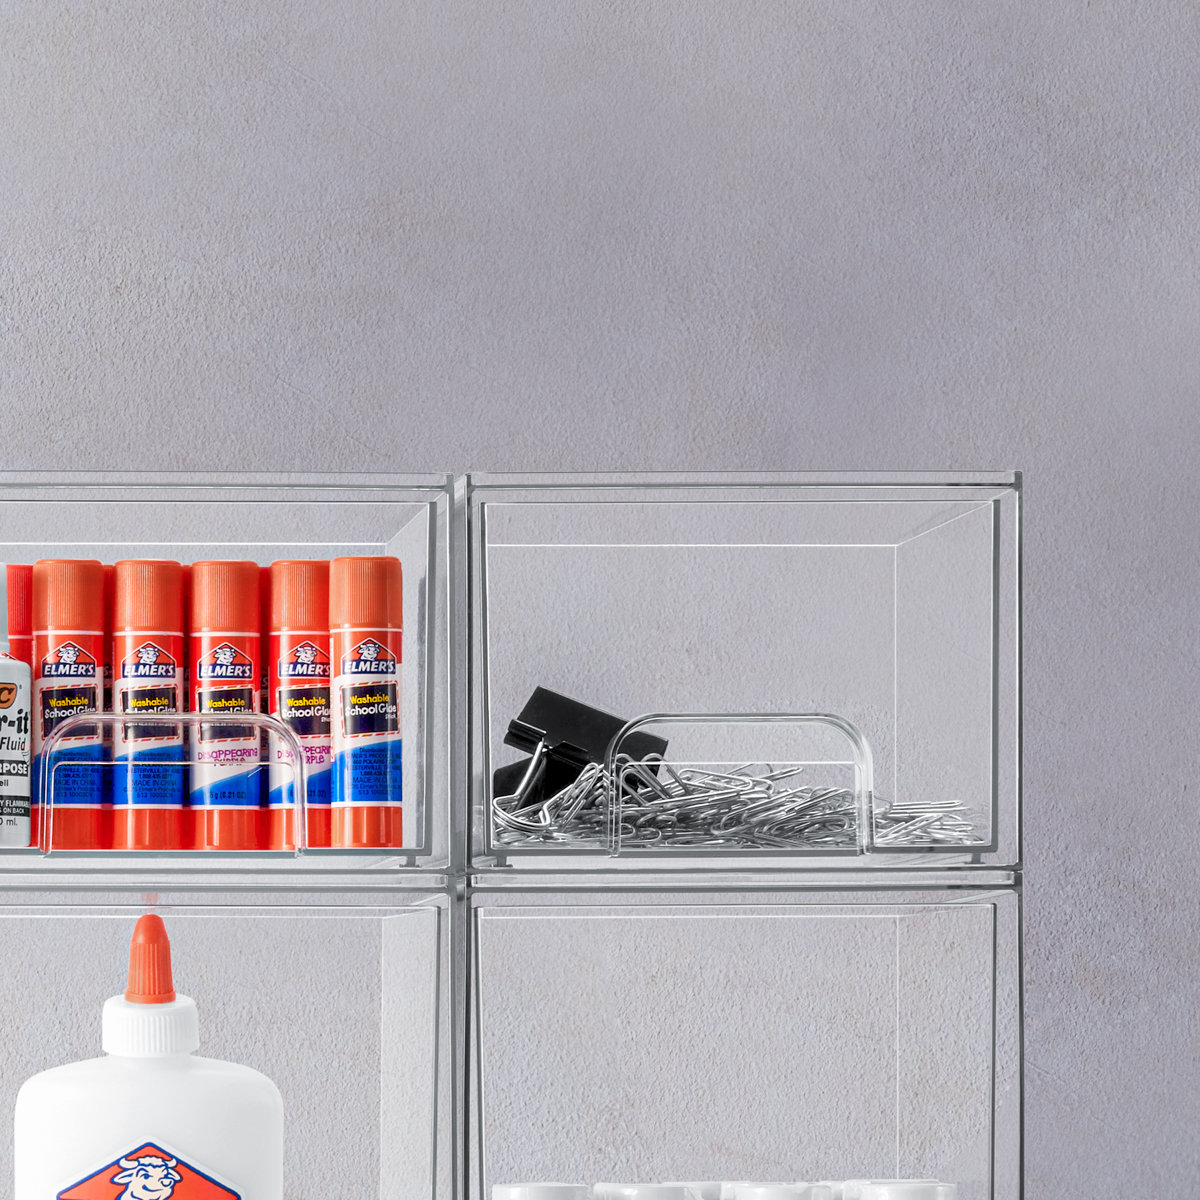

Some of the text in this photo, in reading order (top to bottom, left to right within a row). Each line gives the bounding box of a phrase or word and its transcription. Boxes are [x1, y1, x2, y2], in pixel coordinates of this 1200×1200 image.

[44, 664, 94, 676] ELMER'S
[124, 665, 174, 676] ELMER'S
[201, 665, 251, 677] ELMER'S
[280, 663, 330, 676] ELMER'S
[344, 661, 394, 673] ELMER'S
[49, 697, 89, 707] Washable
[131, 697, 169, 707] Washable
[207, 698, 245, 708] Washable
[287, 697, 326, 706] Washable
[350, 694, 390, 704] Washable
[45, 707, 76, 719] School
[282, 706, 330, 719] School Glu
[345, 703, 397, 717] School Glue
[0, 737, 26, 751] Fluid
[6, 817, 18, 826] ml.
